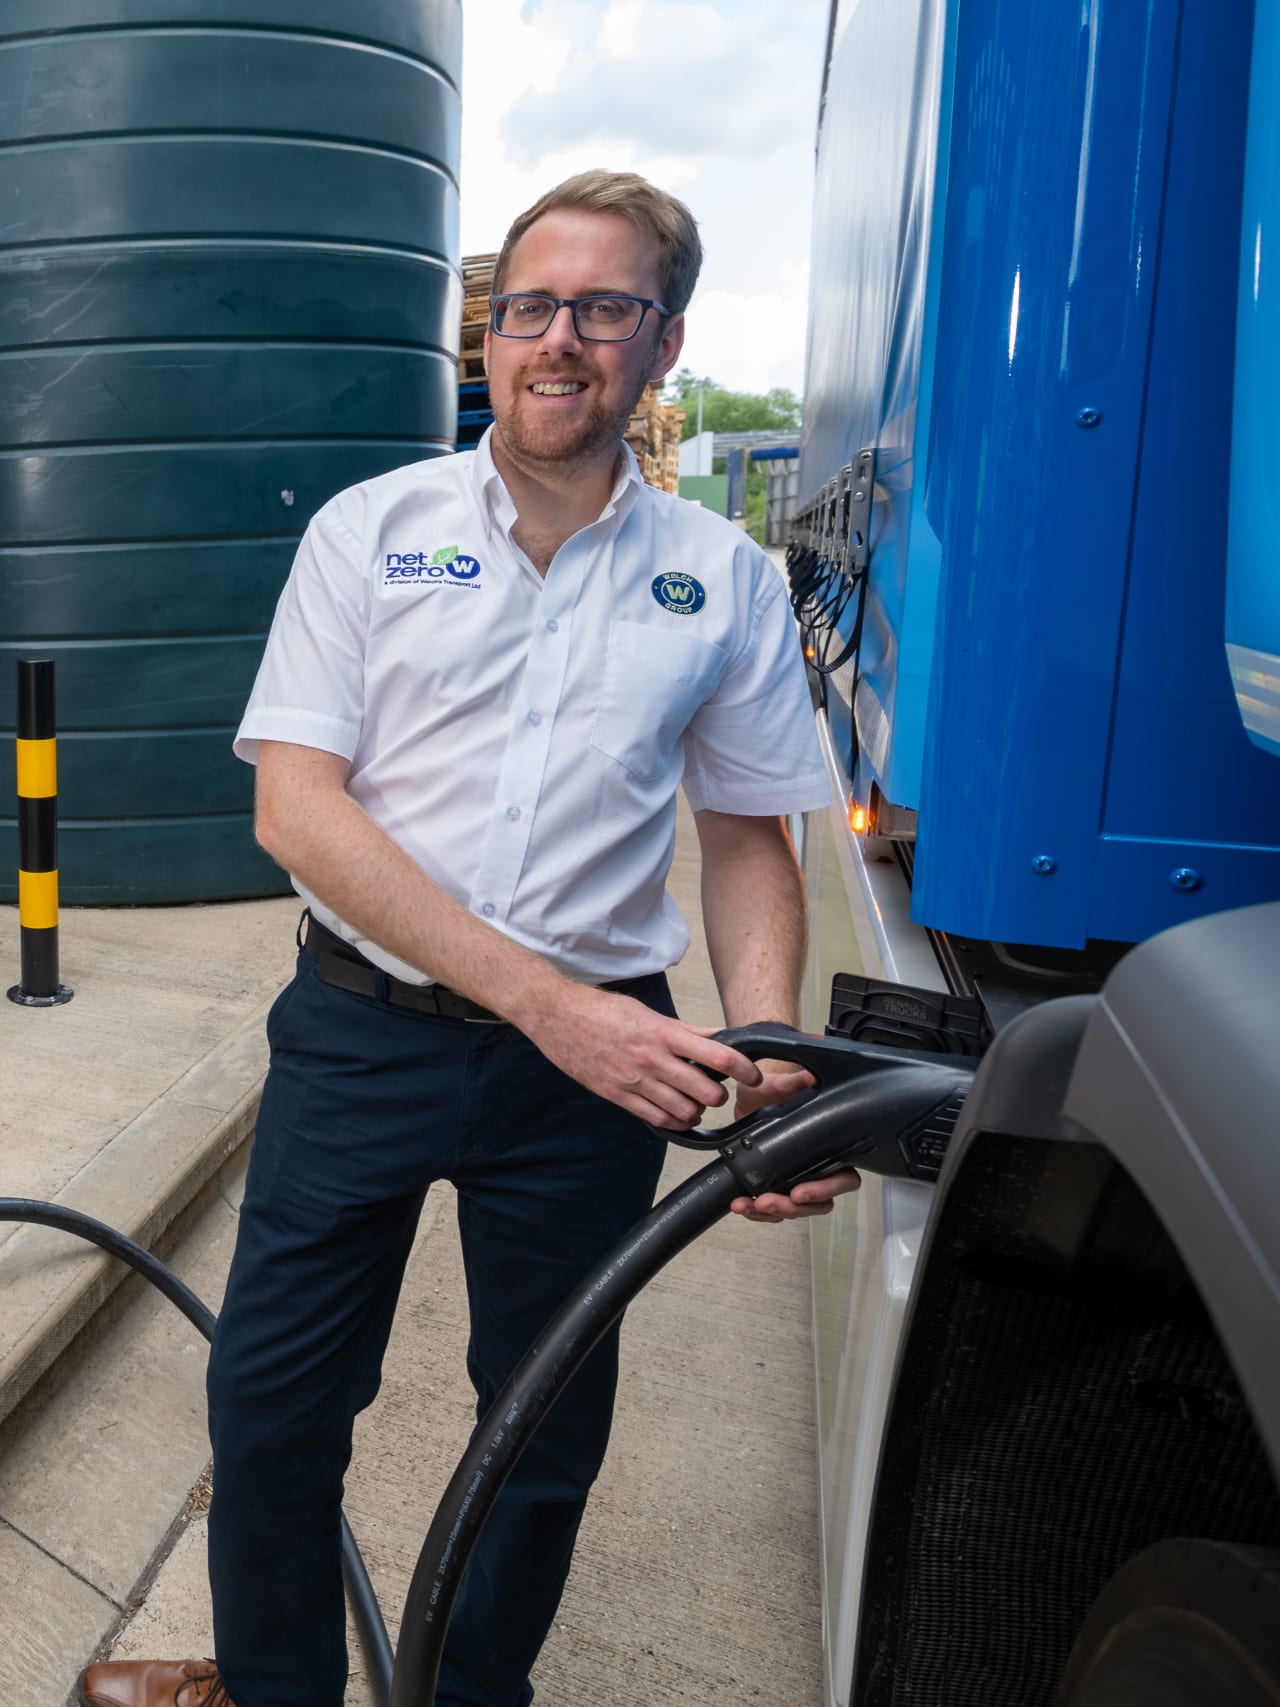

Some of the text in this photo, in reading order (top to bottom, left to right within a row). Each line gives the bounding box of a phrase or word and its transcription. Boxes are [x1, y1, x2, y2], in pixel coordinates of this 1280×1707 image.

[387, 552, 427, 566] net
[386, 566, 444, 578] zero
[451, 560, 475, 574] W
[443, 579, 471, 588] Transport
[662, 573, 692, 582] WELCH
[666, 584, 690, 601] W
[665, 603, 692, 613] GROUP
[884, 1004, 928, 1020] TRUCKS
[583, 1294, 593, 1306] EV
[595, 1270, 615, 1291] CABLE
[706, 1174, 719, 1185] DC
[430, 1580, 442, 1605] CABLE
[482, 1453, 492, 1466] DC
